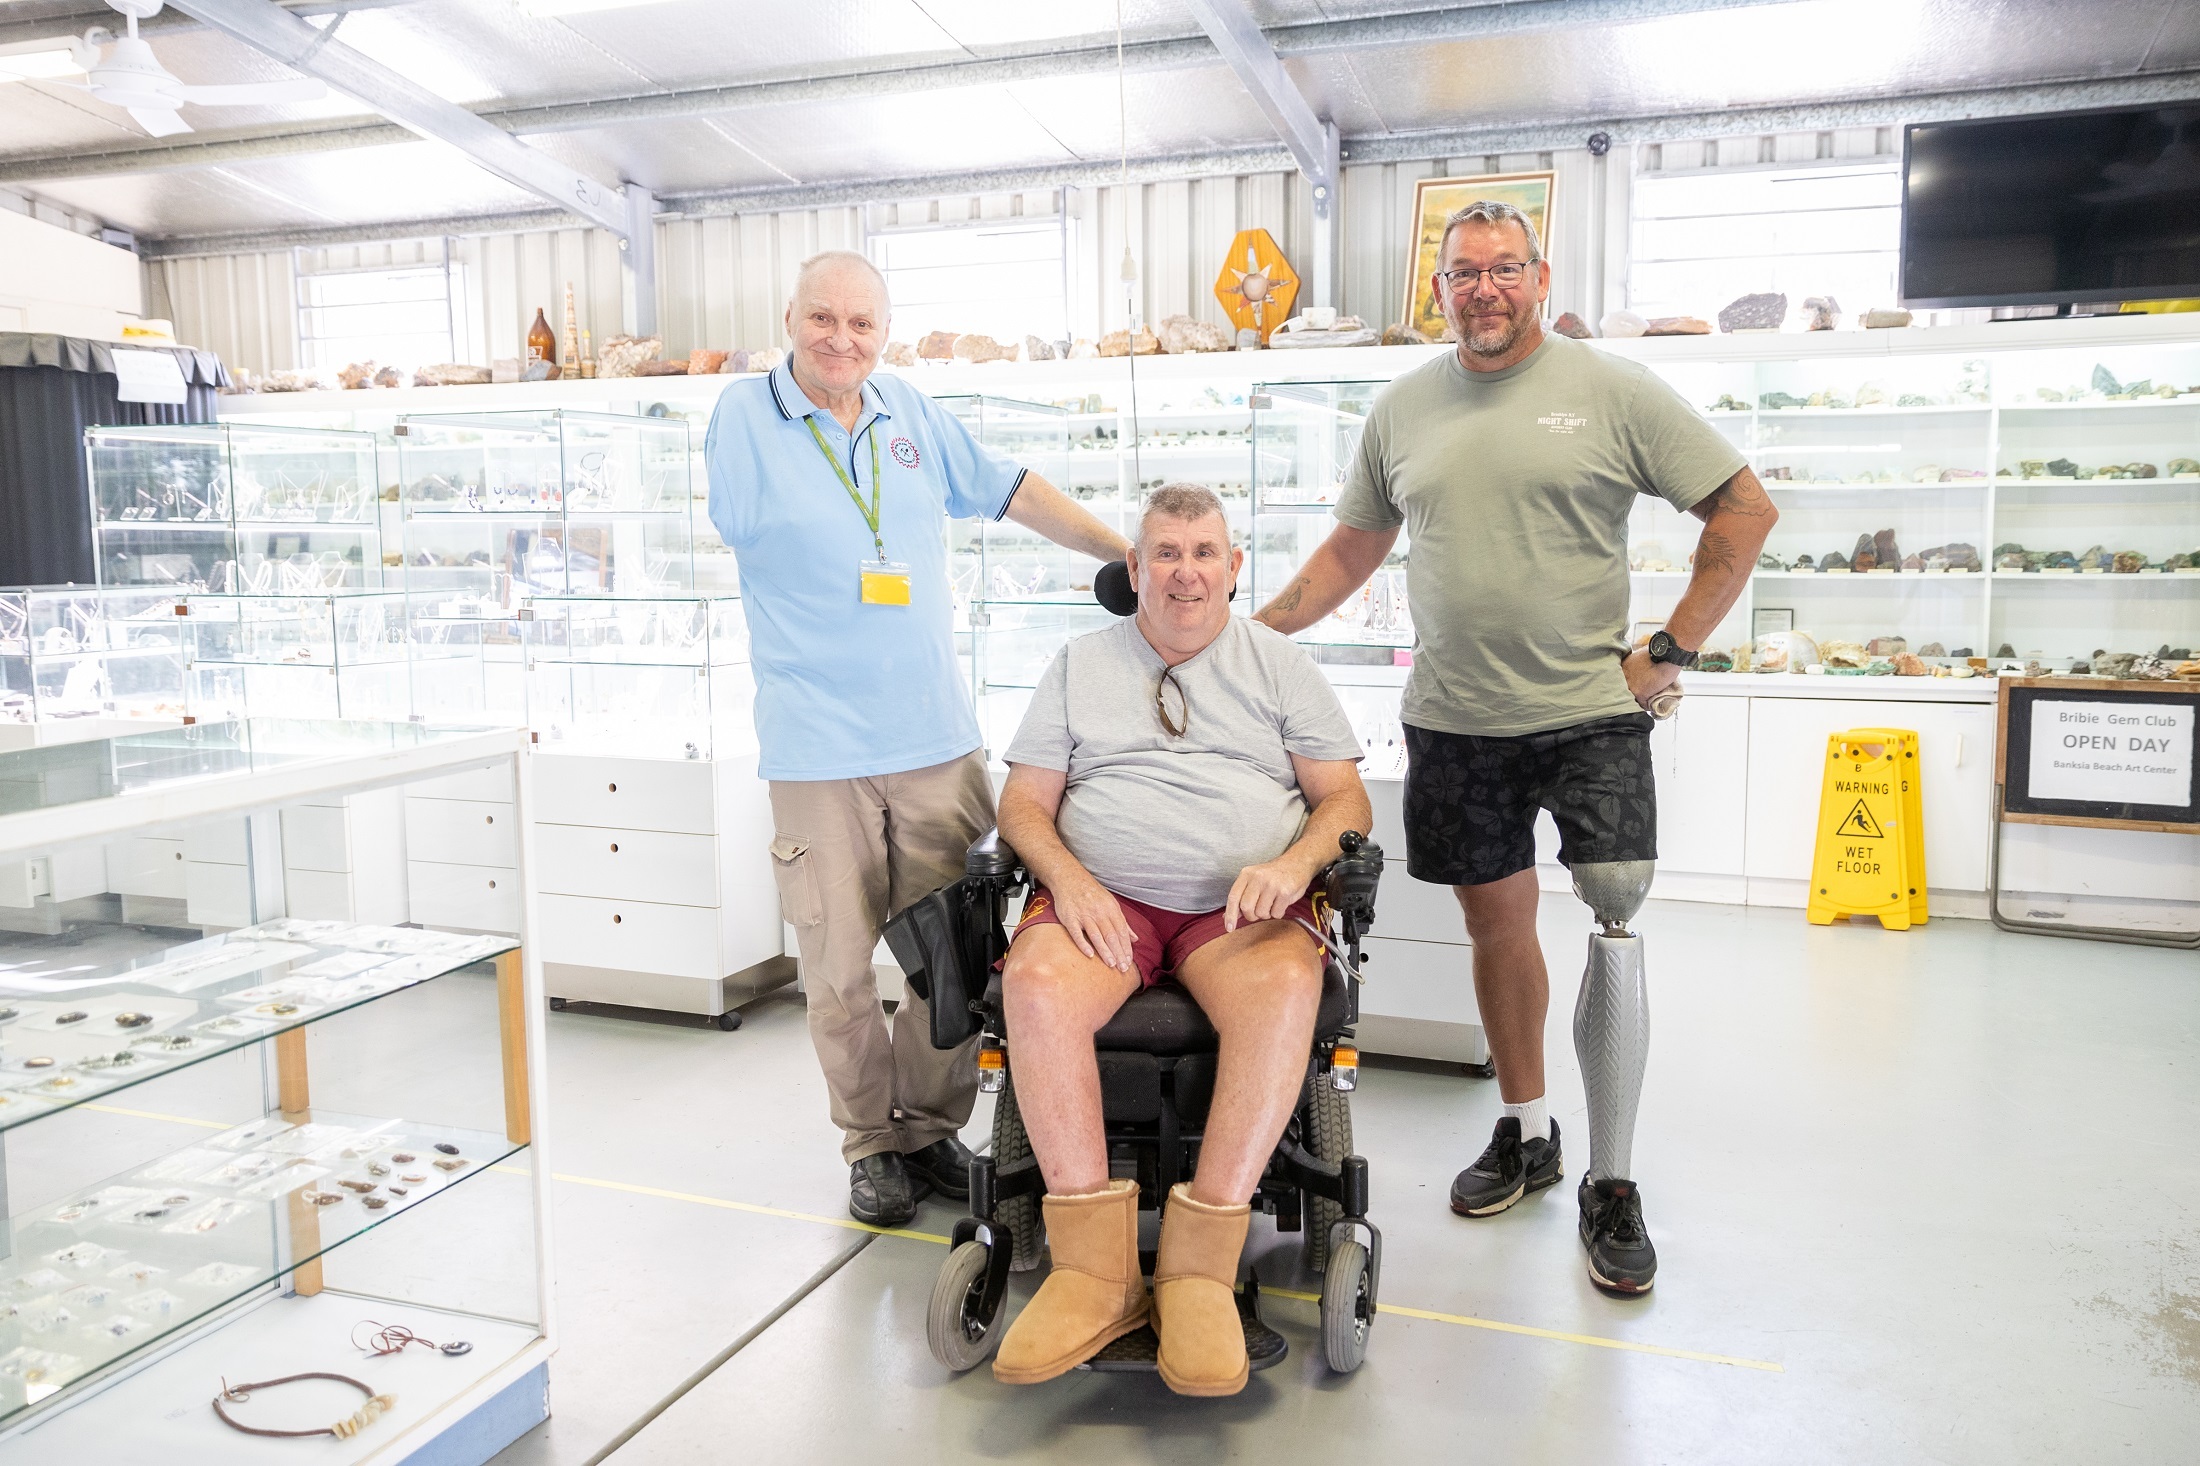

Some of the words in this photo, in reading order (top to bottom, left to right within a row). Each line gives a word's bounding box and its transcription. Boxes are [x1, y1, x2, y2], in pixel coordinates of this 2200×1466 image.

[1537, 417, 1562, 425] NIGHT
[1564, 418, 1588, 426] SHIFT
[2059, 712, 2100, 724] Bribie
[2107, 714, 2140, 725] Gem
[2145, 715, 2177, 727] Club
[2063, 734, 2117, 750] OPEN
[2128, 737, 2171, 753] DAY
[2053, 760, 2091, 770] Banksia
[2093, 762, 2123, 772] Beach
[2125, 764, 2141, 773] Art
[2143, 765, 2178, 774] Center
[1835, 780, 1889, 795] WARNING
[1845, 846, 1874, 859] WET
[1837, 861, 1881, 875] FLOOR
